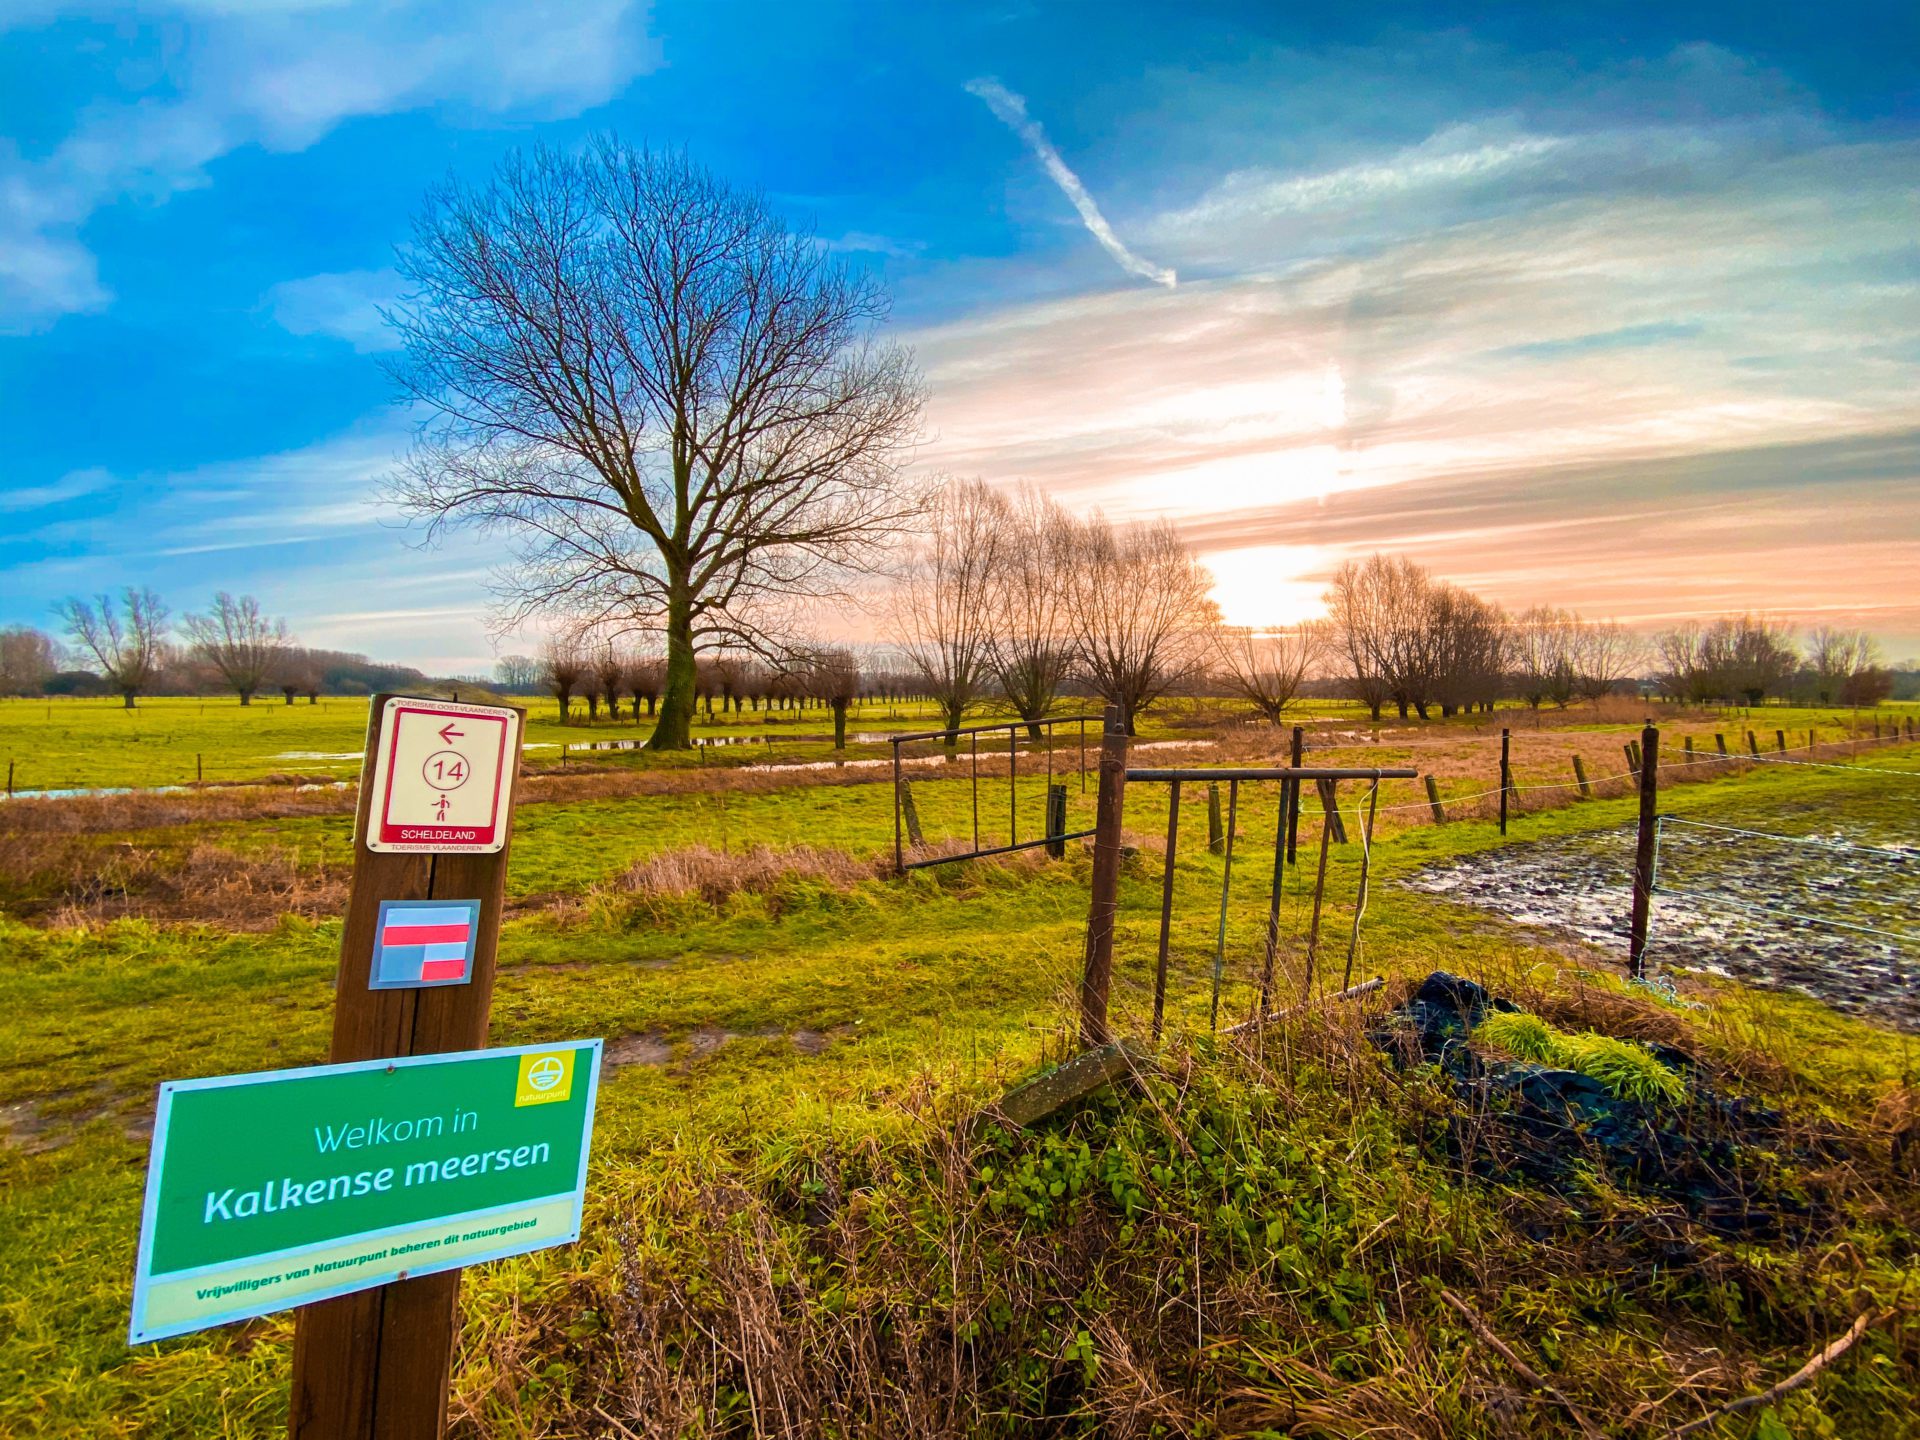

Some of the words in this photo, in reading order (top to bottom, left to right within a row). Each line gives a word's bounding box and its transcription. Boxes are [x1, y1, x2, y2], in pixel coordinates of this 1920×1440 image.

[397, 699, 436, 710] TOERISME
[433, 760, 464, 781] 14
[401, 829, 476, 840] SCHELDELAND
[519, 1089, 567, 1103] natuurpunt
[314, 1116, 443, 1154] Welkom
[453, 1108, 478, 1133] in
[204, 1166, 393, 1224] Kalkense
[404, 1142, 550, 1187] meersen
[196, 1274, 282, 1301] Vrijwilligers
[285, 1267, 311, 1282] van
[314, 1247, 388, 1273] Natuurpunt
[390, 1239, 441, 1257] beheren
[443, 1233, 460, 1248] dit
[462, 1217, 538, 1243] natuurgebied
